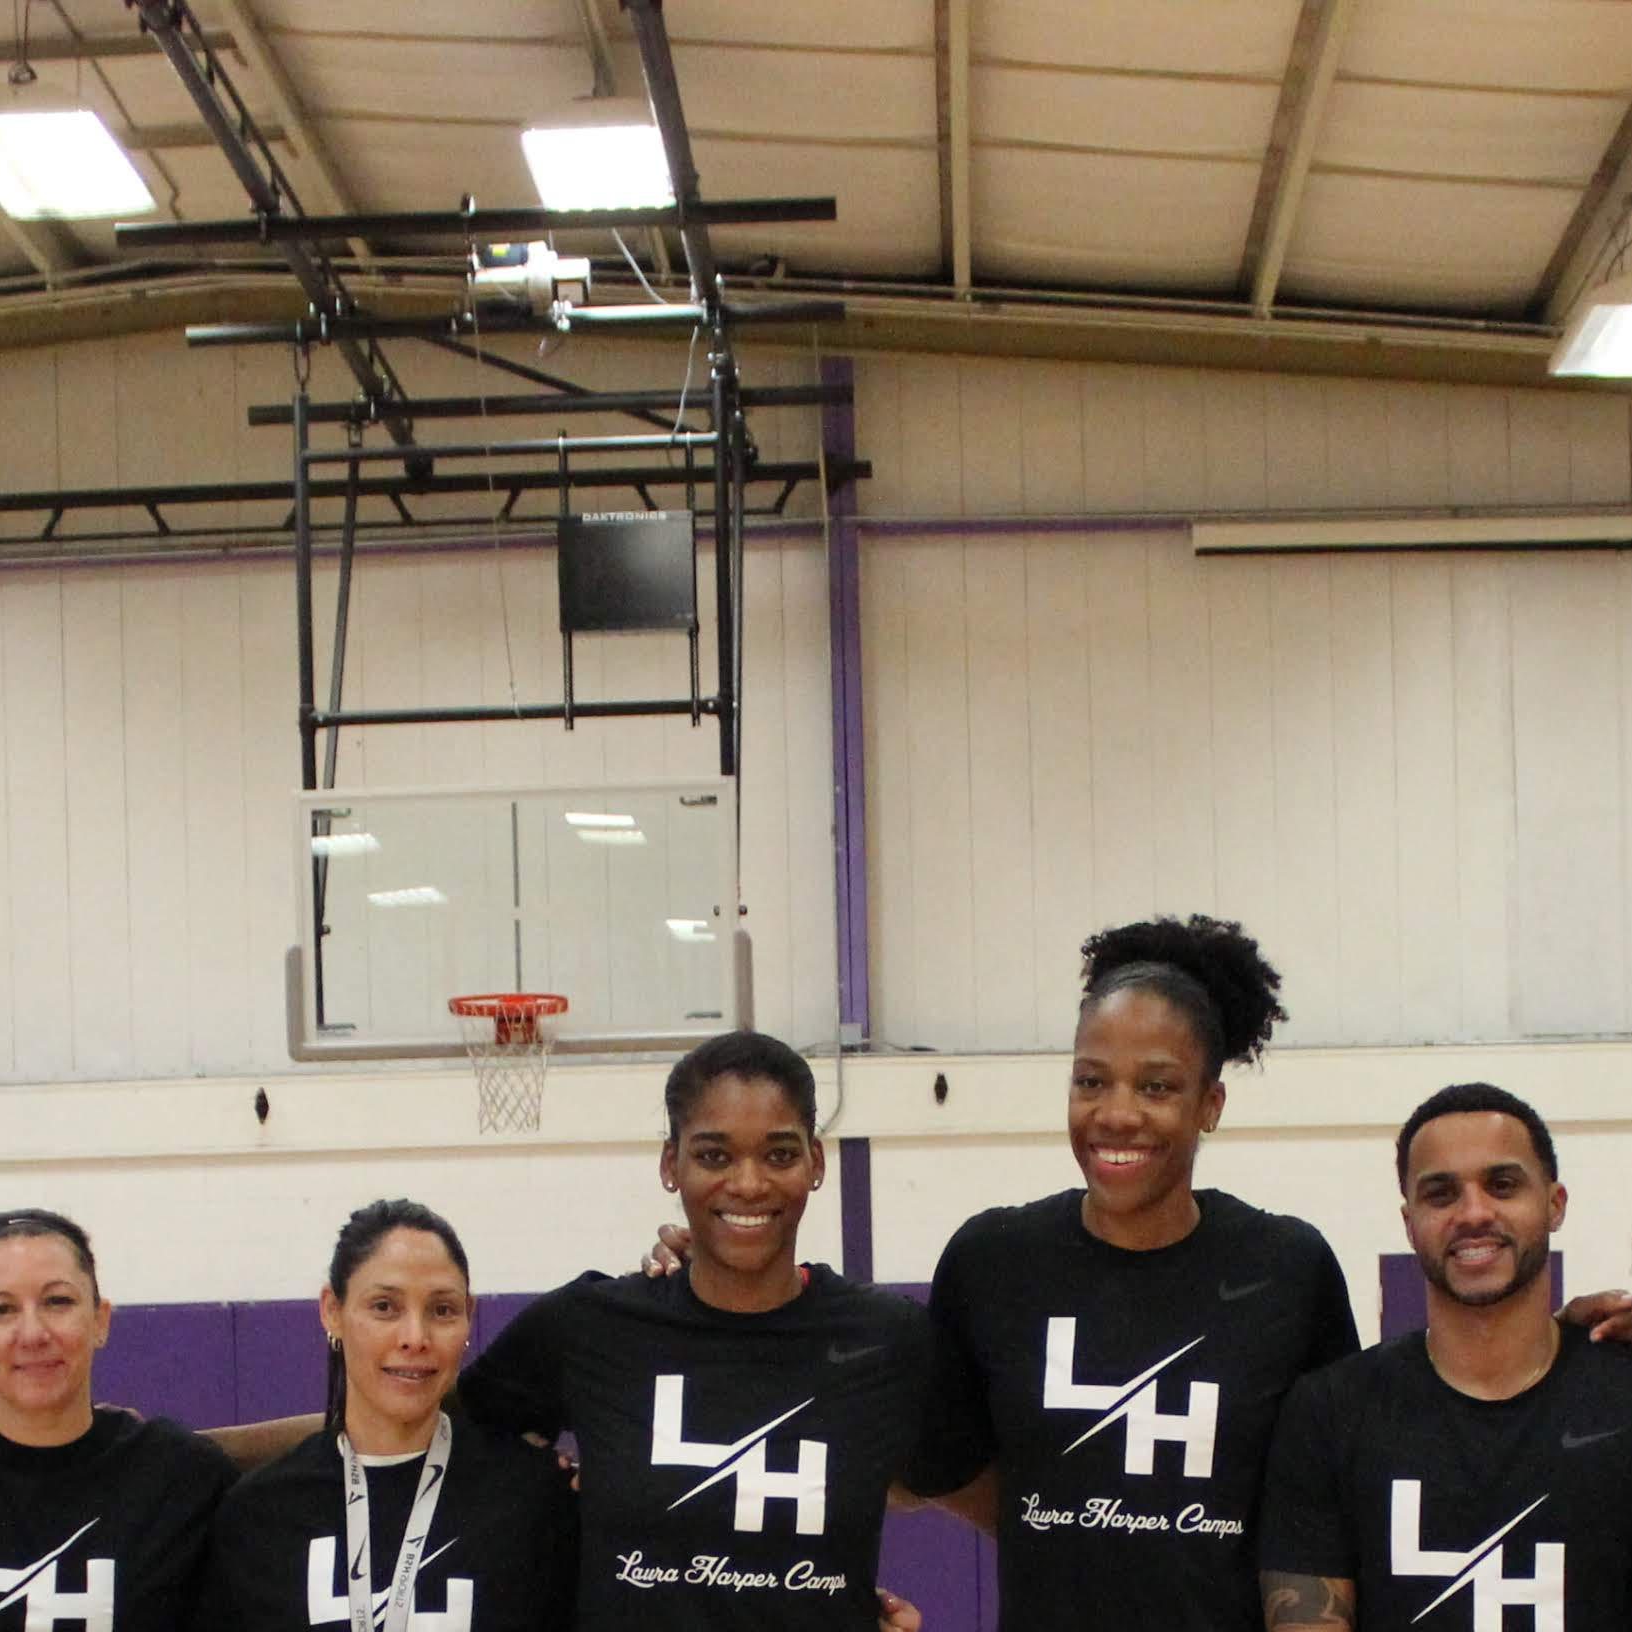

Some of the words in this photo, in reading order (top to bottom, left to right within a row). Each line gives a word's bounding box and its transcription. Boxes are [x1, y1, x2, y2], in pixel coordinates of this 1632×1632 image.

[1021, 1492, 1075, 1530] Laura
[1079, 1498, 1170, 1534] Harper
[1176, 1503, 1245, 1539] Camps
[616, 1550, 679, 1588] Laura
[684, 1555, 779, 1592] Harper
[784, 1560, 848, 1596] Camps
